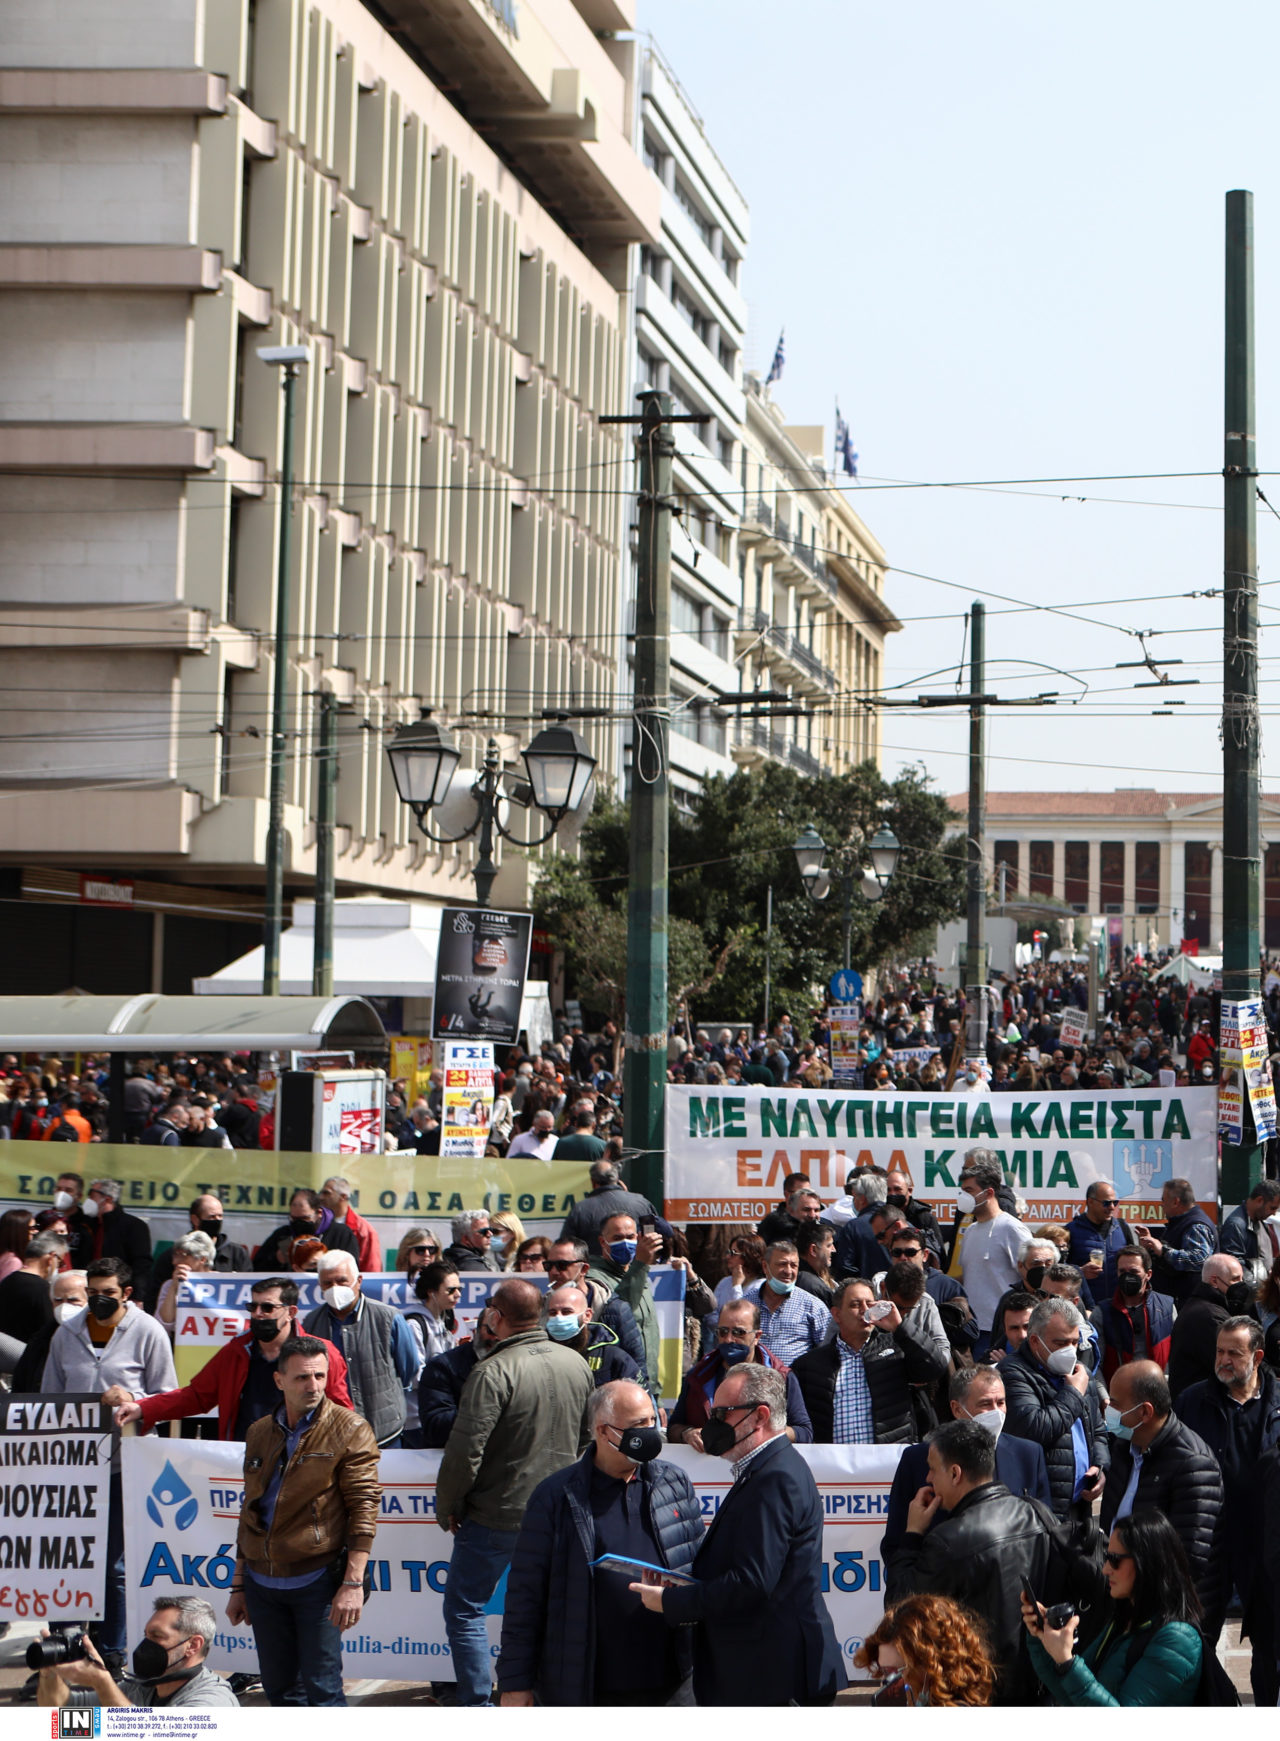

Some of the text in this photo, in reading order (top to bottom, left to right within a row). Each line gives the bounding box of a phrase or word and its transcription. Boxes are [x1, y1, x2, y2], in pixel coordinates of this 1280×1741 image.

[440, 1013, 464, 1030] 6/4
[452, 1047, 490, 1059] ΓΣΕ
[450, 1070, 467, 1080] 24
[688, 1095, 1192, 1140] ΜΕ ΝΑΥΠΗΓΕΙΑ ΚΛΕΙΣΤΑ
[925, 1149, 1080, 1188] ΚΜΙΑ
[379, 1190, 464, 1211] ΟΑΣΑ
[688, 1202, 767, 1218] ΣΩΜΑΤΕΙΟ
[180, 1315, 251, 1337] ΑΥΞ
[6, 1402, 101, 1430] ΕΥΔΑΠ
[0, 1484, 98, 1518] ΙΟΥΣΙΑΣ
[39, 1536, 96, 1569] ΜΑΣ
